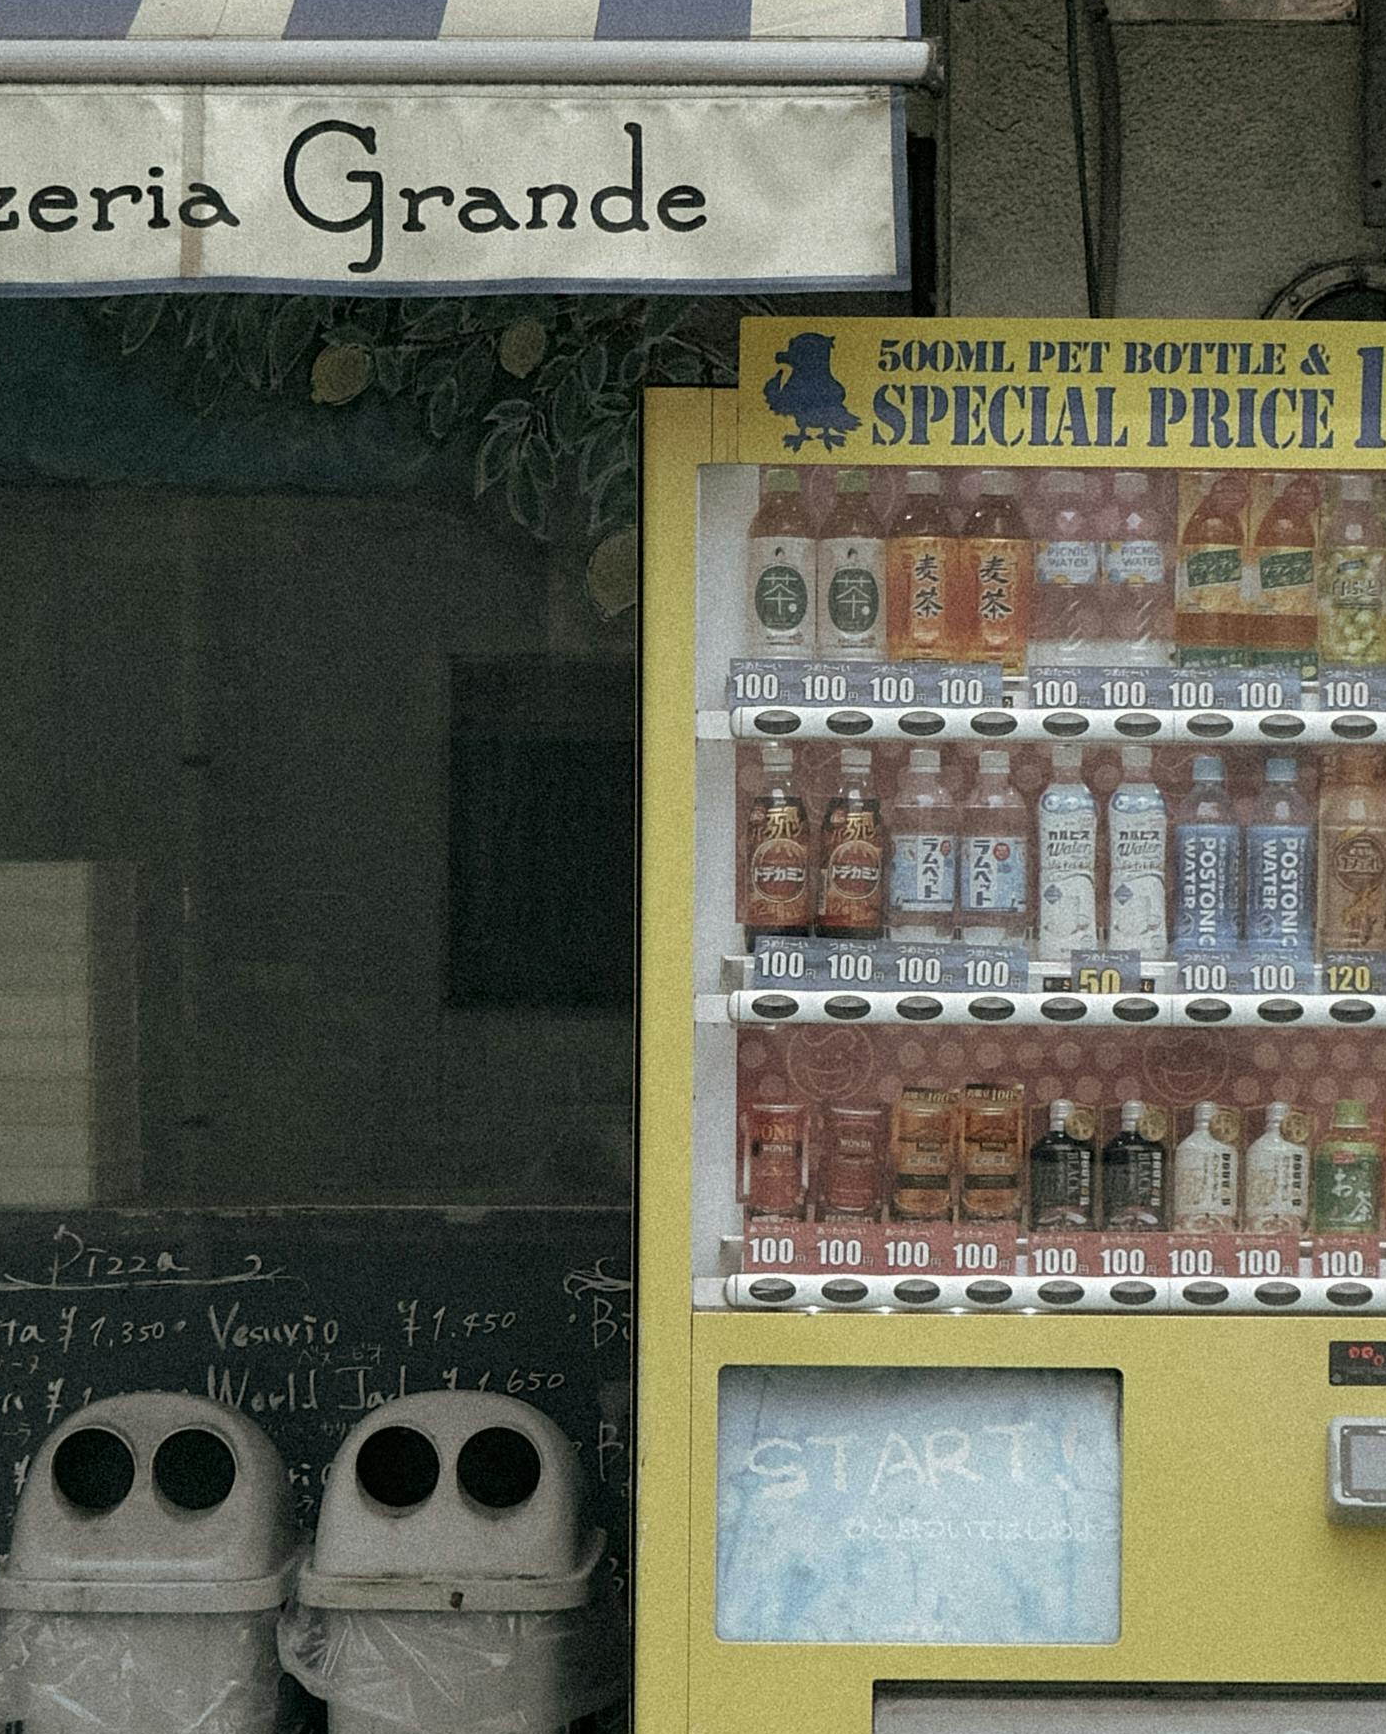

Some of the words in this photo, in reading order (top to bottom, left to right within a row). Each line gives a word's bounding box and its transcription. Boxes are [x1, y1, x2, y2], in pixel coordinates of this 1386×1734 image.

[283, 120, 708, 273] Grande
[878, 340, 1015, 374] 500ML
[1027, 341, 1112, 375] PET
[1123, 341, 1288, 376] BOTTLE
[1299, 342, 1332, 376] &
[872, 384, 1129, 448] SPECIAL
[1145, 386, 1335, 450] PRICE
[913, 554, 944, 618] 麦茶
[980, 556, 1013, 620] 麦茶
[1183, 837, 1196, 909] WATER
[1199, 837, 1217, 947] POSTONIC
[1263, 839, 1277, 910] WATER
[1280, 837, 1298, 947] POSTONIC
[48, 1224, 190, 1288] Pizza
[208, 1301, 339, 1350] Vesuvio
